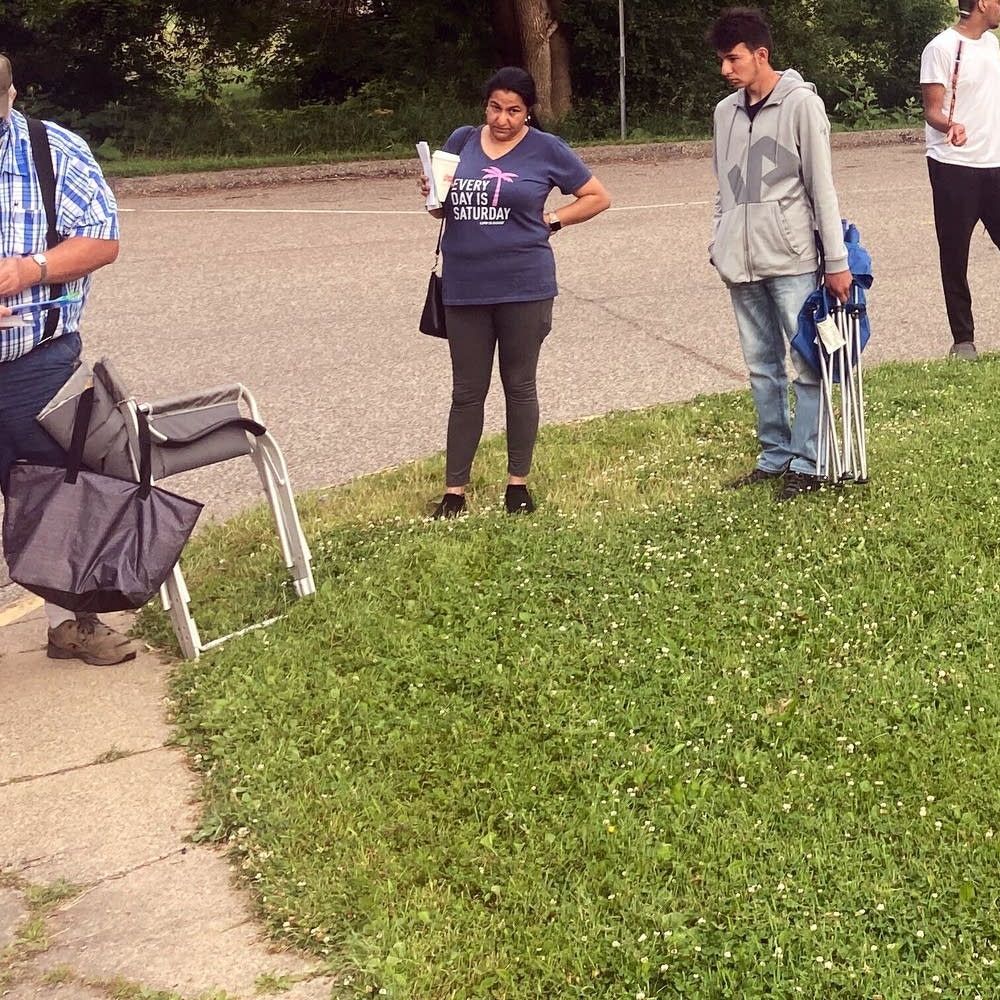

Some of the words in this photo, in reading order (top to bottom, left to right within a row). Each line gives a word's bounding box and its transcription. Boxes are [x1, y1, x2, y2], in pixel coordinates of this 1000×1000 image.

[451, 178, 490, 191] EVERY
[451, 191, 473, 206] DAY
[476, 191, 489, 206] IS
[453, 206, 511, 221] SATURDAY
